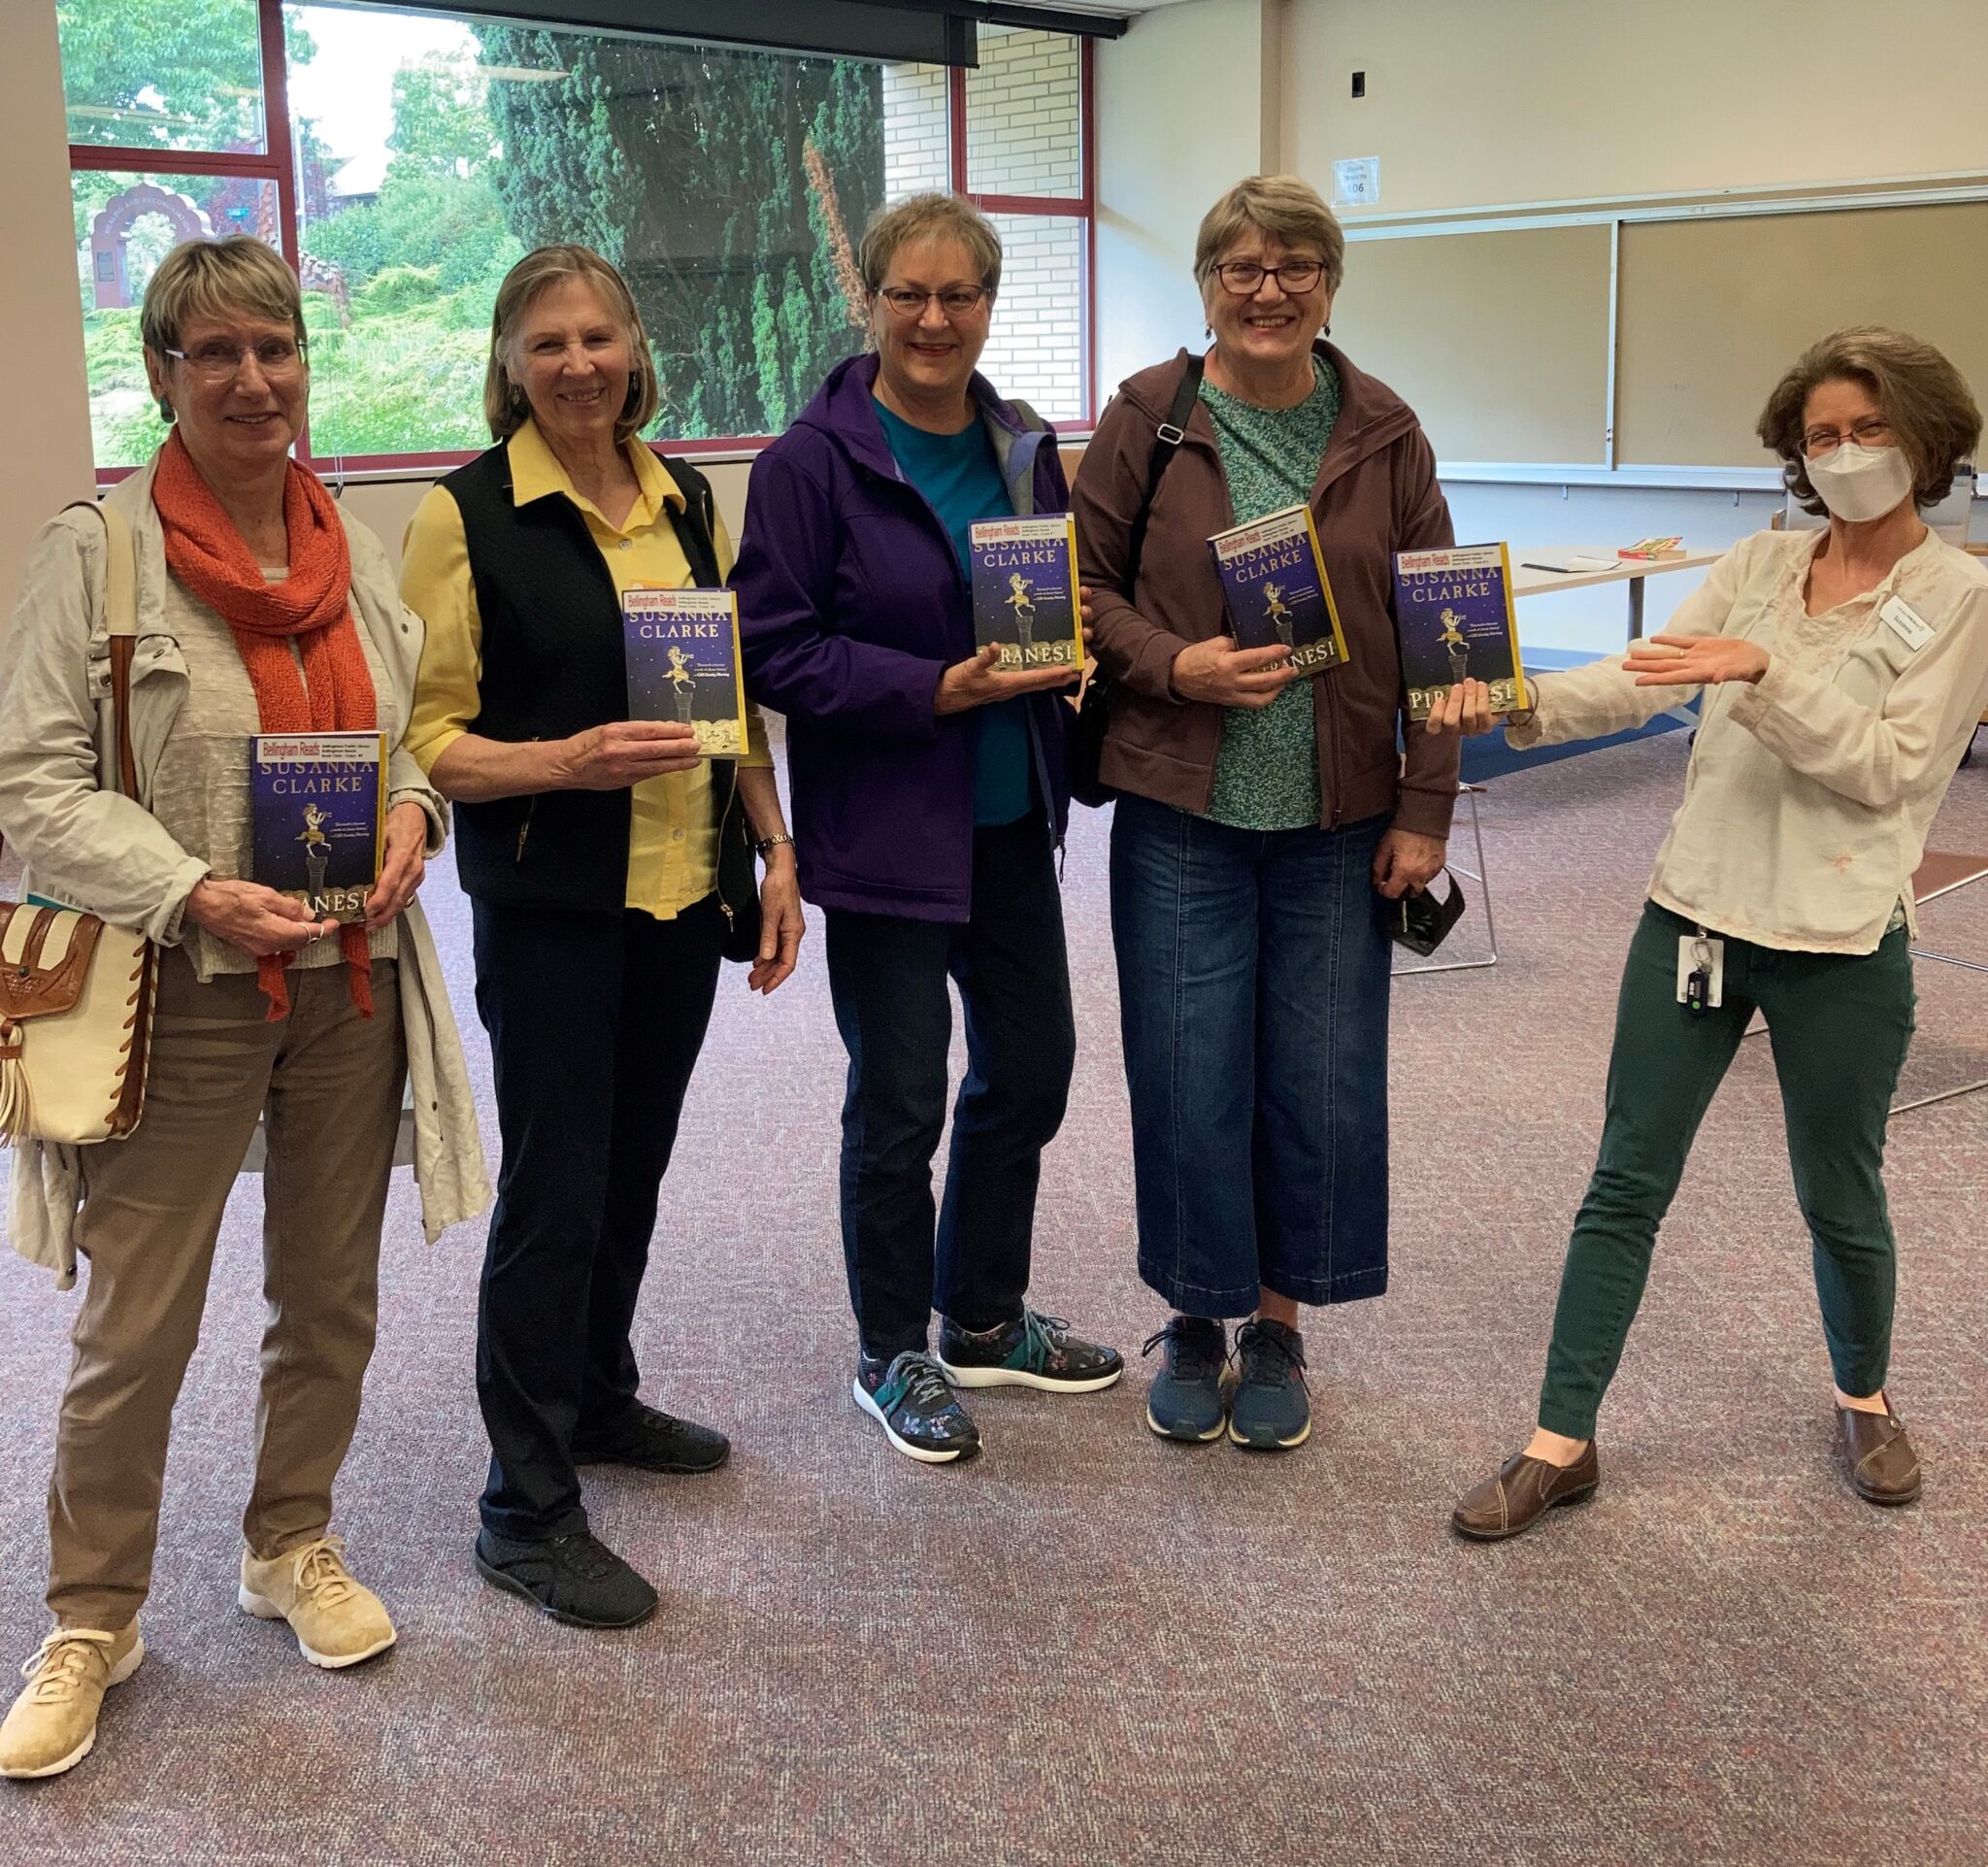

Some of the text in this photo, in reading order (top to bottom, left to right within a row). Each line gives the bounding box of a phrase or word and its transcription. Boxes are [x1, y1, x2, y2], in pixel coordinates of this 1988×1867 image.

[125, 196, 140, 209] AND
[973, 538, 1065, 553] SUSANNA
[1223, 532, 1308, 572] SUSANNA
[983, 550, 1057, 568] CLARKE
[1235, 549, 1304, 583] CLARKE
[1400, 566, 1499, 587] SUSANNA
[1411, 582, 1491, 603] CLARKE
[628, 612, 729, 623] SUSANNA
[640, 623, 719, 639] CLARKE
[999, 645, 1073, 664] RANESI
[1270, 641, 1336, 672] ANESI
[1409, 683, 1512, 710] PIRSI
[262, 741, 321, 760] Bellingham Reads
[260, 761, 375, 776] SUSANNA
[272, 776, 363, 795] CLARKE
[301, 890, 369, 914] ANESI
